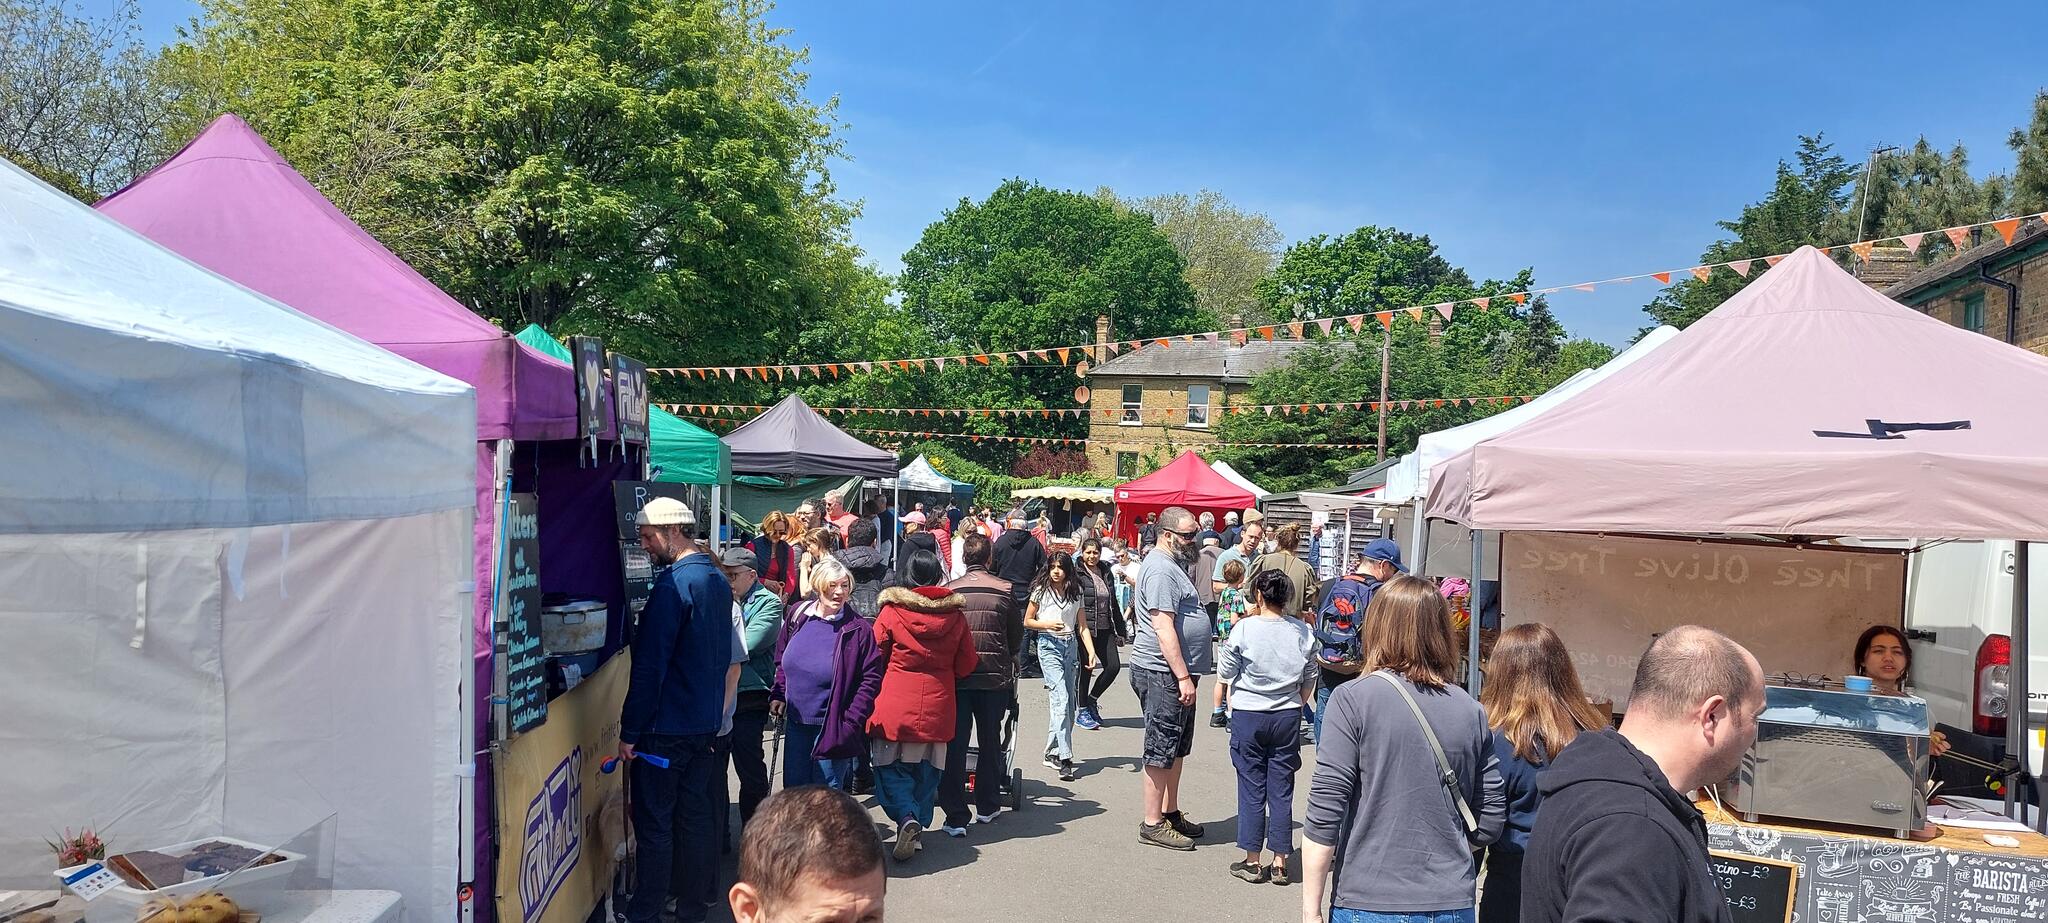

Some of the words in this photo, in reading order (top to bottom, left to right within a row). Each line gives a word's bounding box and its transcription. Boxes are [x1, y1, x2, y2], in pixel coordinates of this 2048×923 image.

[1973, 868, 2029, 893] BARISTA
[1997, 892, 2020, 904] FRESH
[1975, 902, 2019, 916] Passionate
